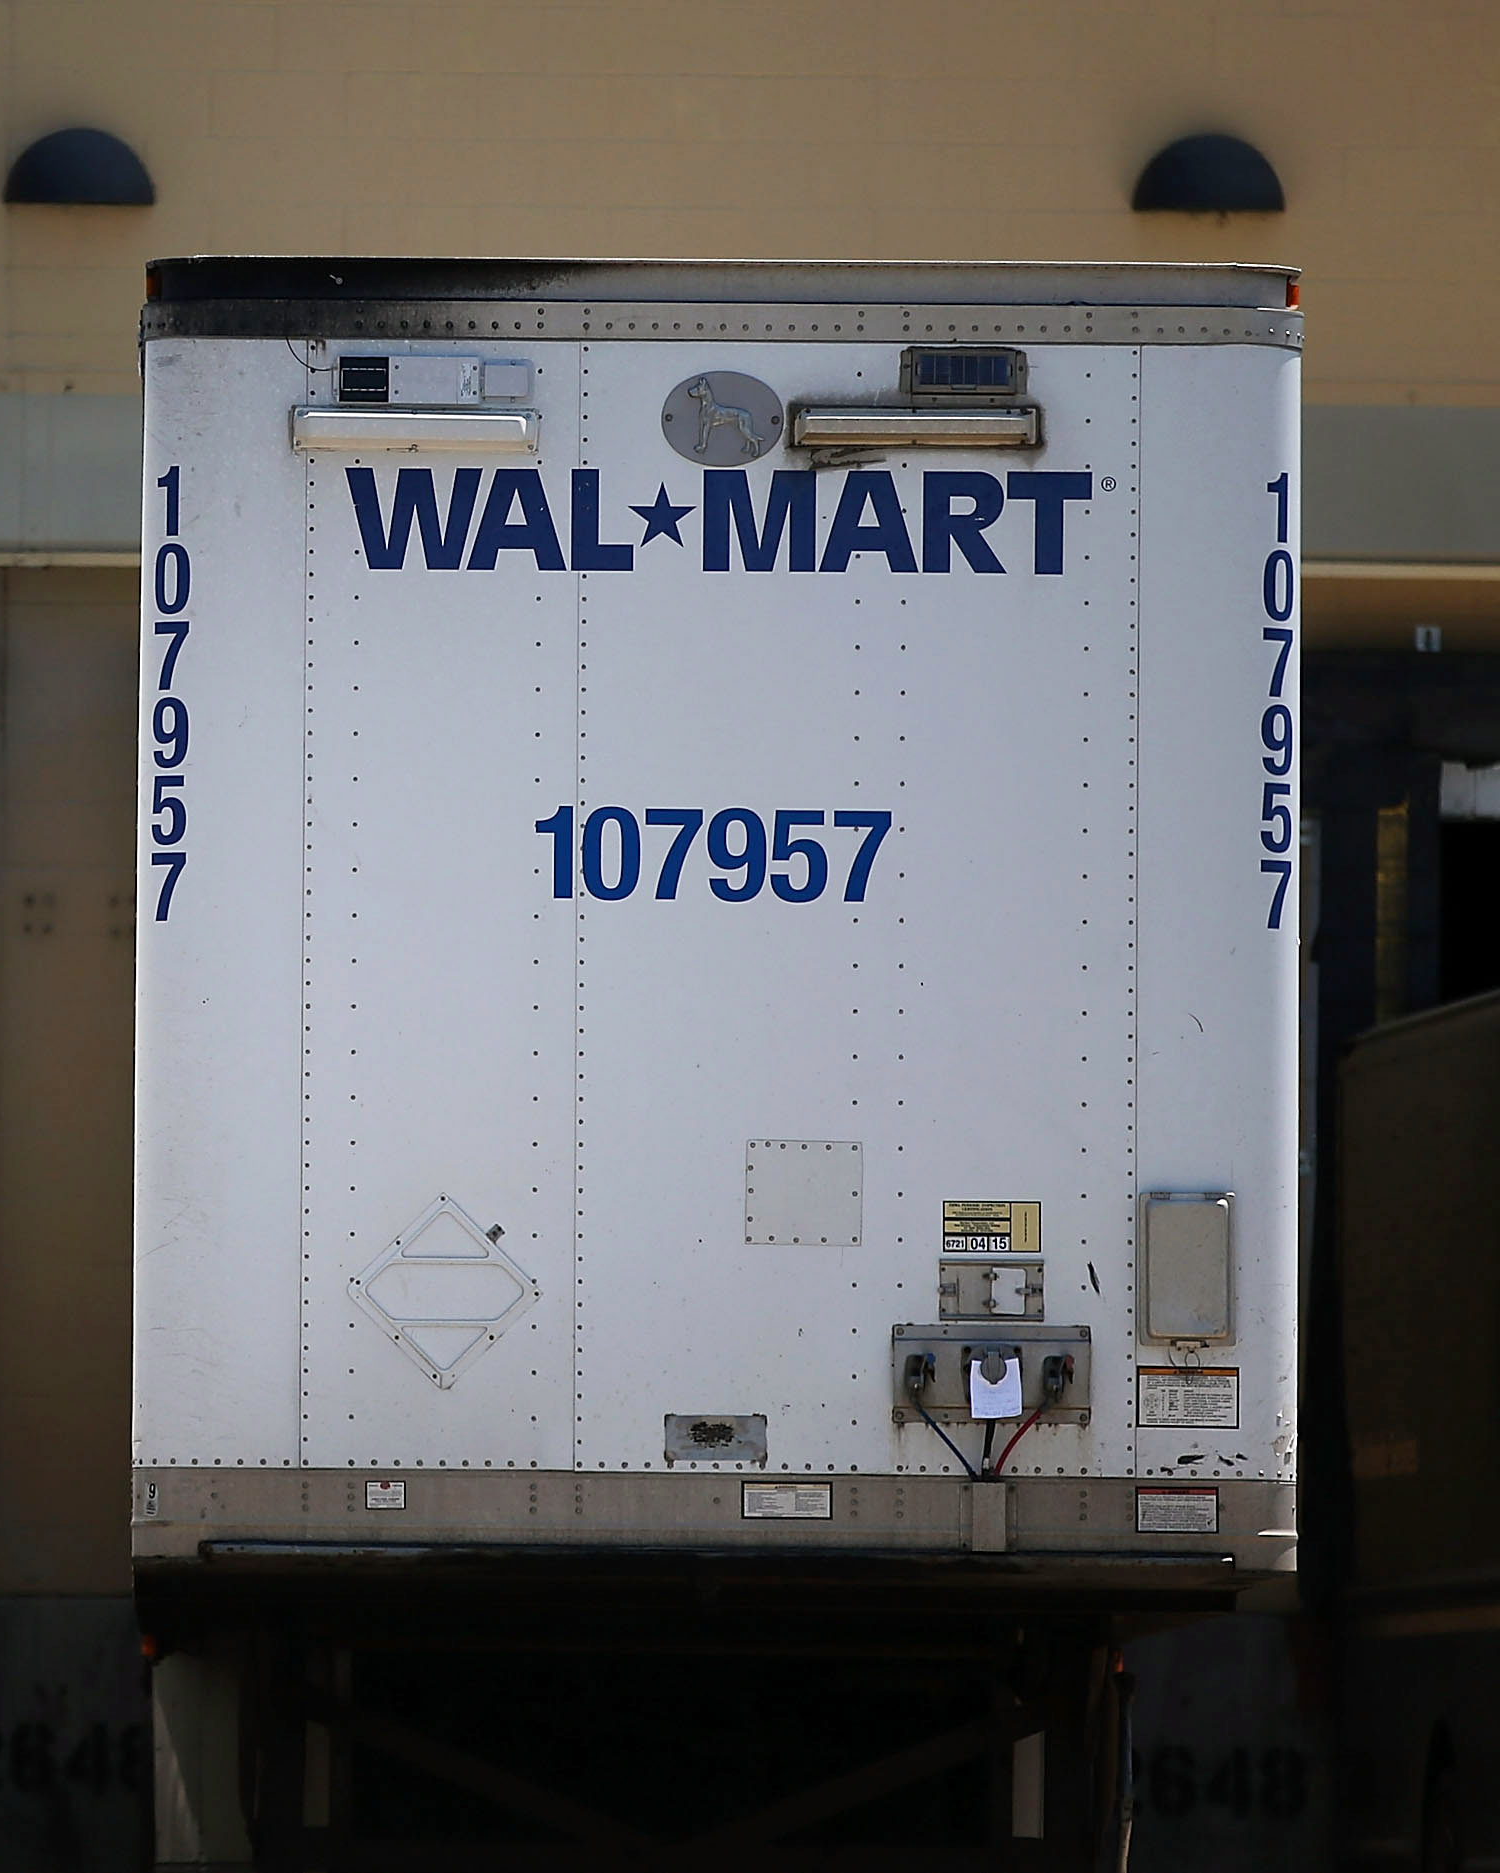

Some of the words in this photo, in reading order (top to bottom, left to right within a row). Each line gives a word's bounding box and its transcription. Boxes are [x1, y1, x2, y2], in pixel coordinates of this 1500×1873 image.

[150, 465, 192, 921] 107957
[1260, 473, 1294, 930] 107957
[535, 805, 893, 904] 107957
[970, 1237, 986, 1250] 04
[992, 1237, 1007, 1250] 15
[1134, 1744, 1306, 1816] 648
